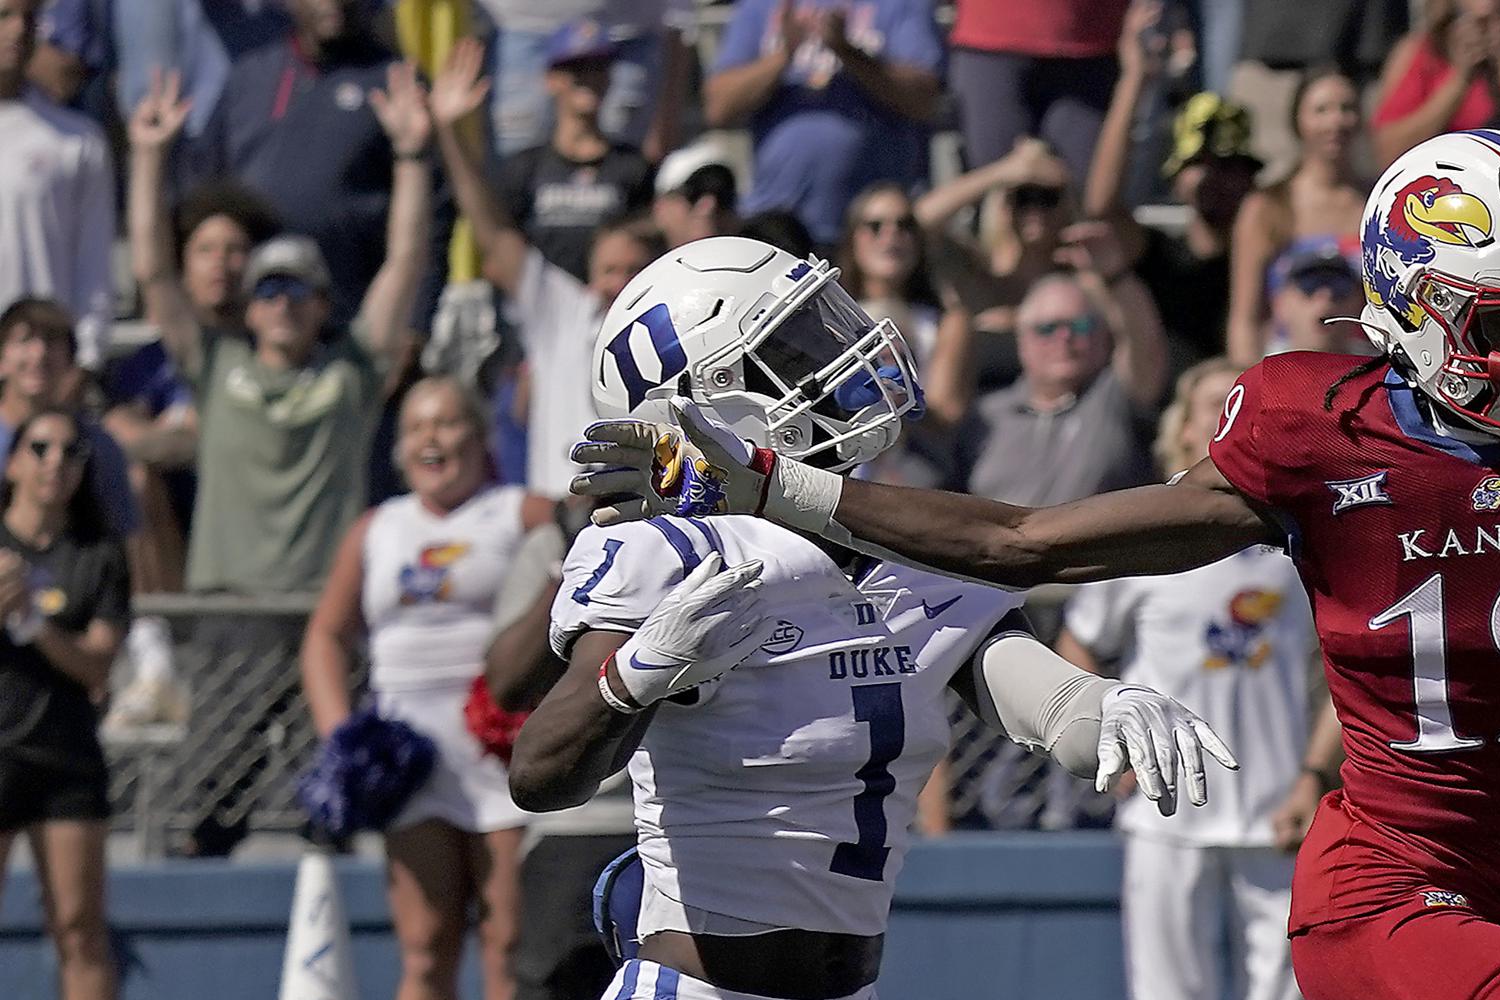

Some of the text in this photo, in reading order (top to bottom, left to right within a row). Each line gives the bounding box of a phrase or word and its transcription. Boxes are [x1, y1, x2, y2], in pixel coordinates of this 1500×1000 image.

[571, 538, 625, 607] 1
[829, 646, 917, 680] DUKE
[829, 682, 905, 882] 1
